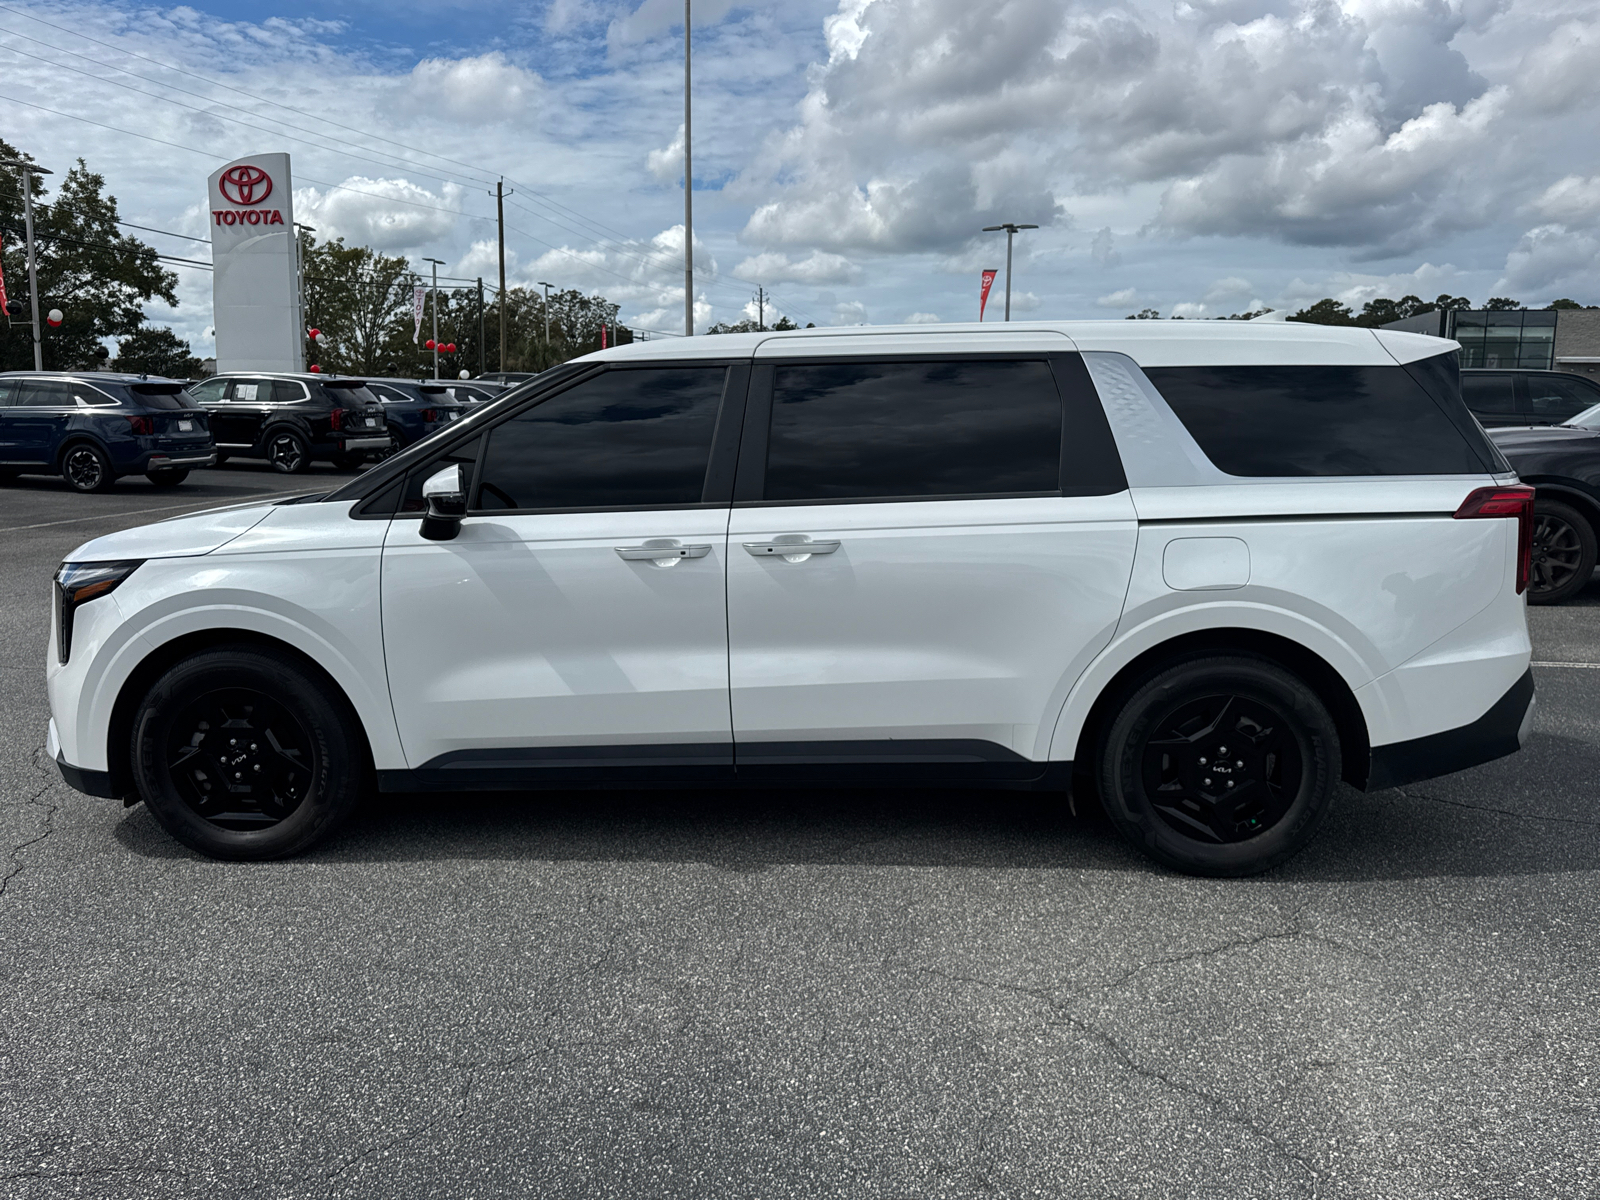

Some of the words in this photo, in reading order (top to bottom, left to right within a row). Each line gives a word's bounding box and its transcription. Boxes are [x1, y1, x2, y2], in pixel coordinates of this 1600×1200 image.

[212, 210, 284, 226] TOYOTA
[231, 754, 247, 766] KIA
[1122, 716, 1149, 793] NEXEN
[1213, 766, 1232, 774] KIA
